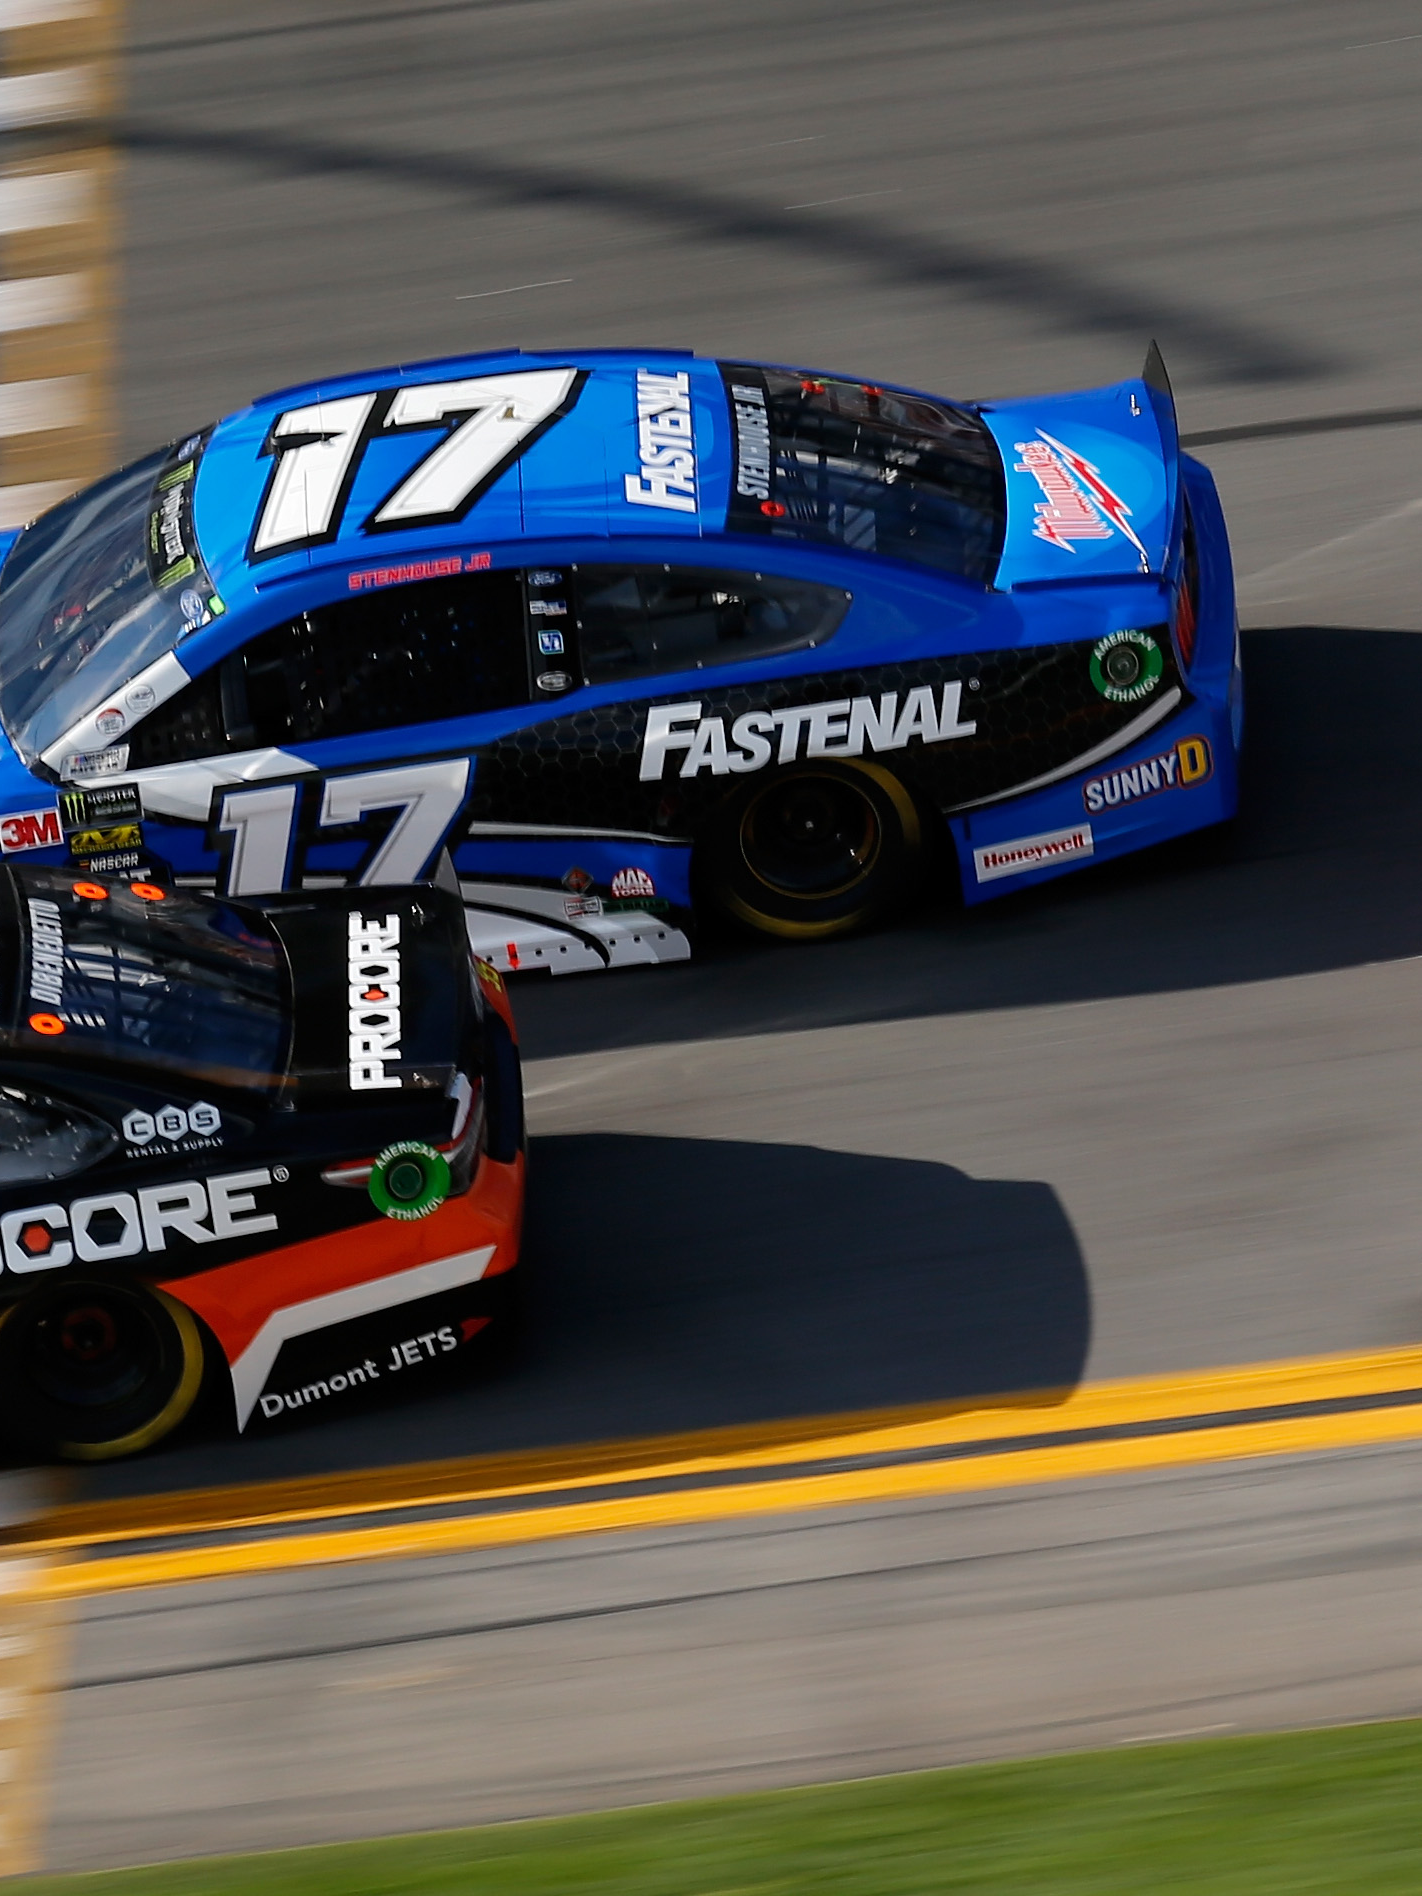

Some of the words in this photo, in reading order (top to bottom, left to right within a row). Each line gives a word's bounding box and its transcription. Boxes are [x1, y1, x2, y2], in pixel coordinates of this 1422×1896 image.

[624, 368, 697, 513] FASTENAL
[735, 403, 771, 500] STENHOUSE
[253, 366, 581, 556] 17
[348, 557, 461, 590] STENHOUSE
[465, 552, 491, 572] JR
[1094, 629, 1156, 661] AMERICAN
[1103, 674, 1159, 702] ETHANOL
[639, 679, 977, 781] FASTENAL
[1, 812, 62, 850] 3M
[219, 757, 470, 896] 17
[90, 852, 138, 872] NASCAR
[983, 832, 1085, 870] Honeywell
[612, 867, 655, 889] MAC
[613, 887, 655, 898] TOOLS
[28, 898, 64, 1006] DIBENEDETTO
[348, 911, 402, 1090] PROCORE
[126, 1104, 218, 1141] CBS
[125, 1144, 169, 1159] RENTAL
[182, 1137, 224, 1152] SUPPLY
[375, 1141, 440, 1170] AMERICAN
[387, 1195, 444, 1221] ETHANOL
[259, 1358, 380, 1418] Dumont
[388, 1326, 458, 1372] JETS
